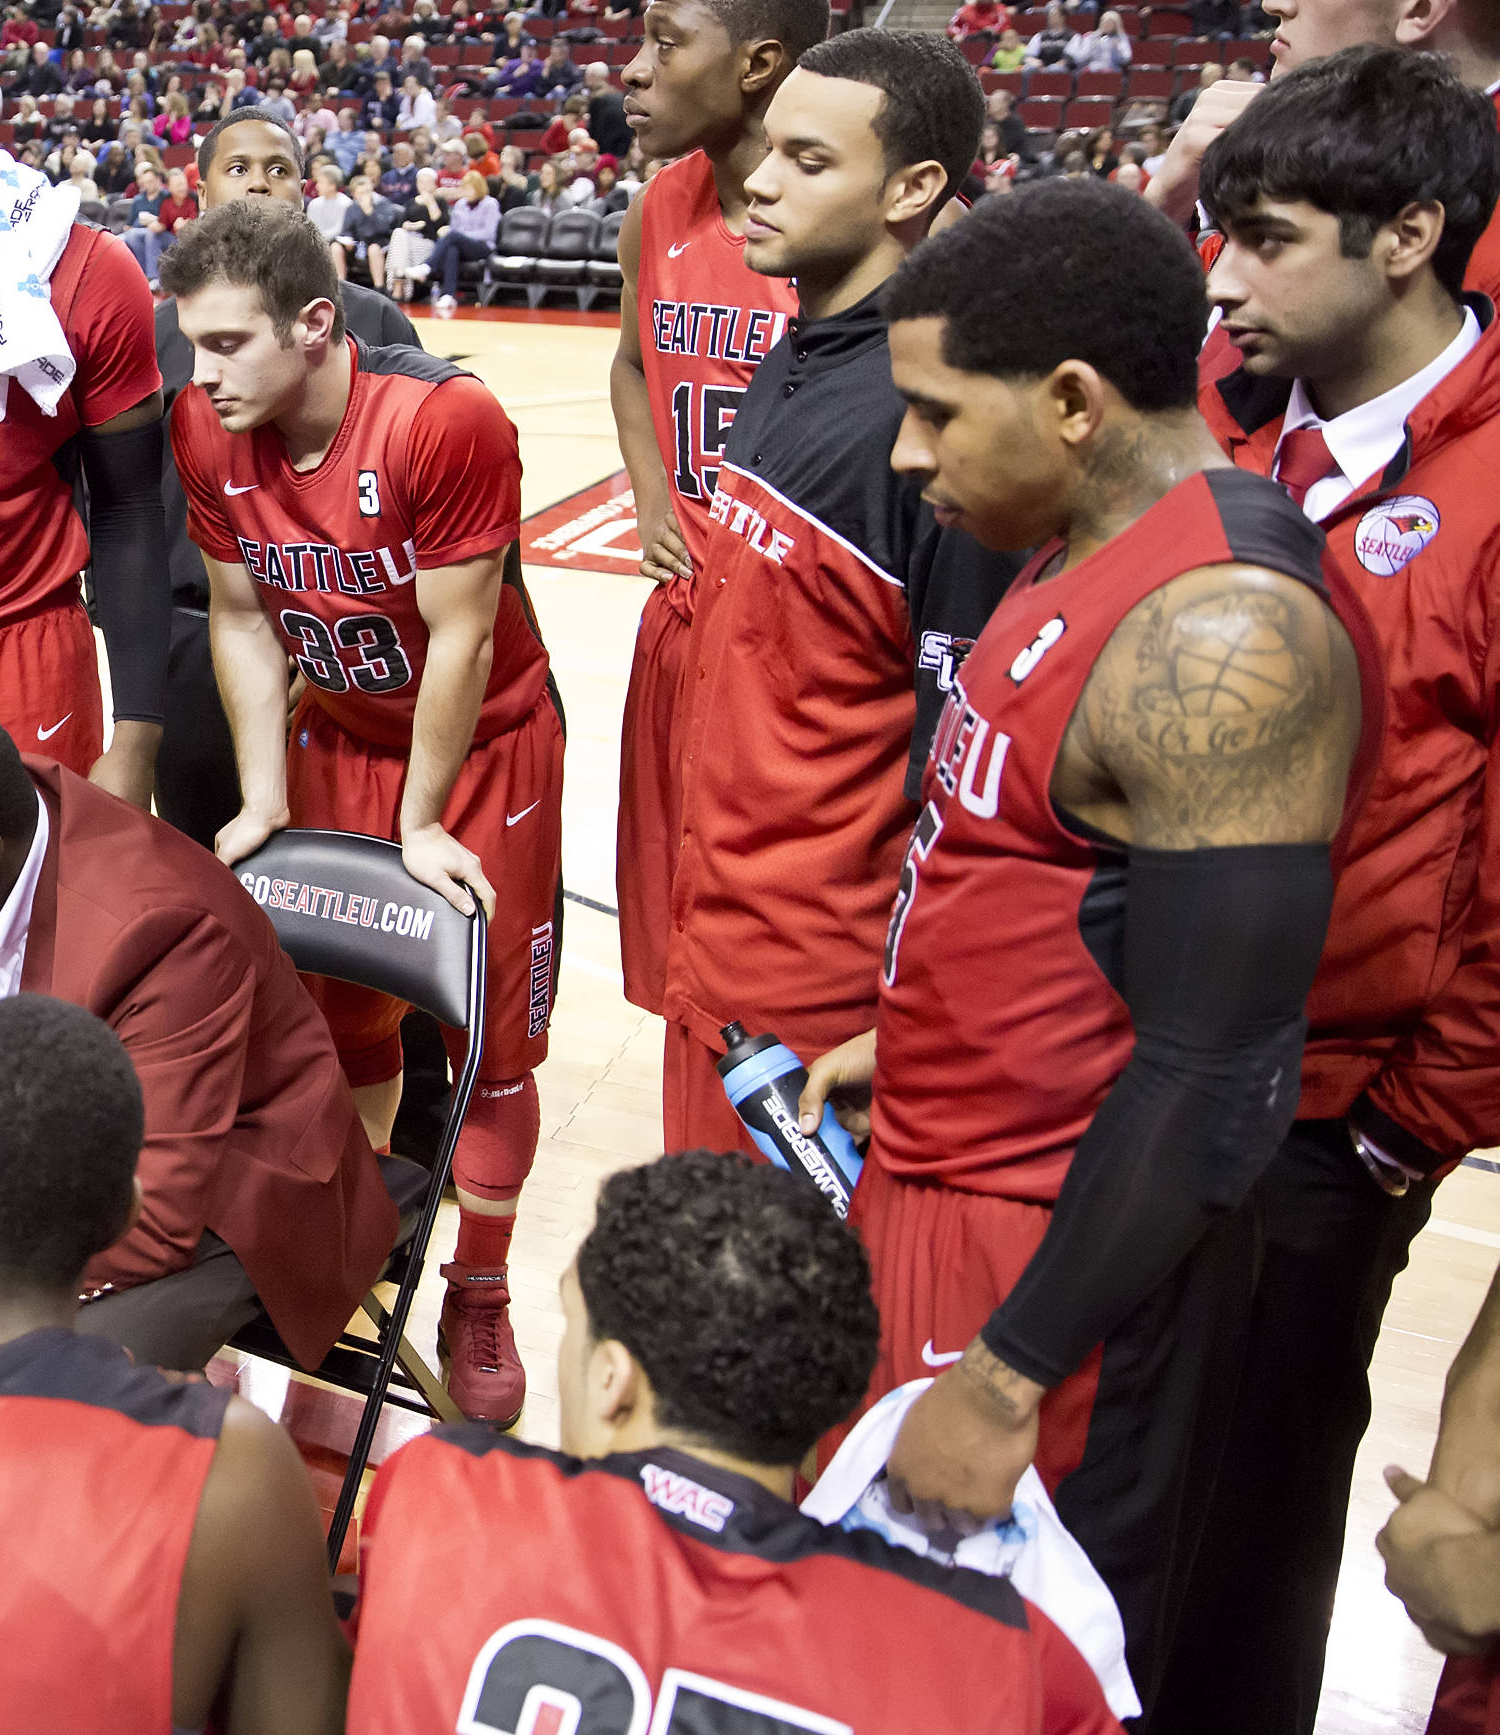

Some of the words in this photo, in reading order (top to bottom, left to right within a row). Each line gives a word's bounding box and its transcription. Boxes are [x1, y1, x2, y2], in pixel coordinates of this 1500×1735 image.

[358, 471, 380, 516] 3
[237, 536, 416, 595] EATTLEU
[280, 609, 413, 694] 33
[1010, 618, 1065, 681] 3
[240, 872, 435, 940] GOSEATTLEU.COM
[528, 920, 553, 1039] SEATTLEU
[640, 1463, 735, 1534] WAC
